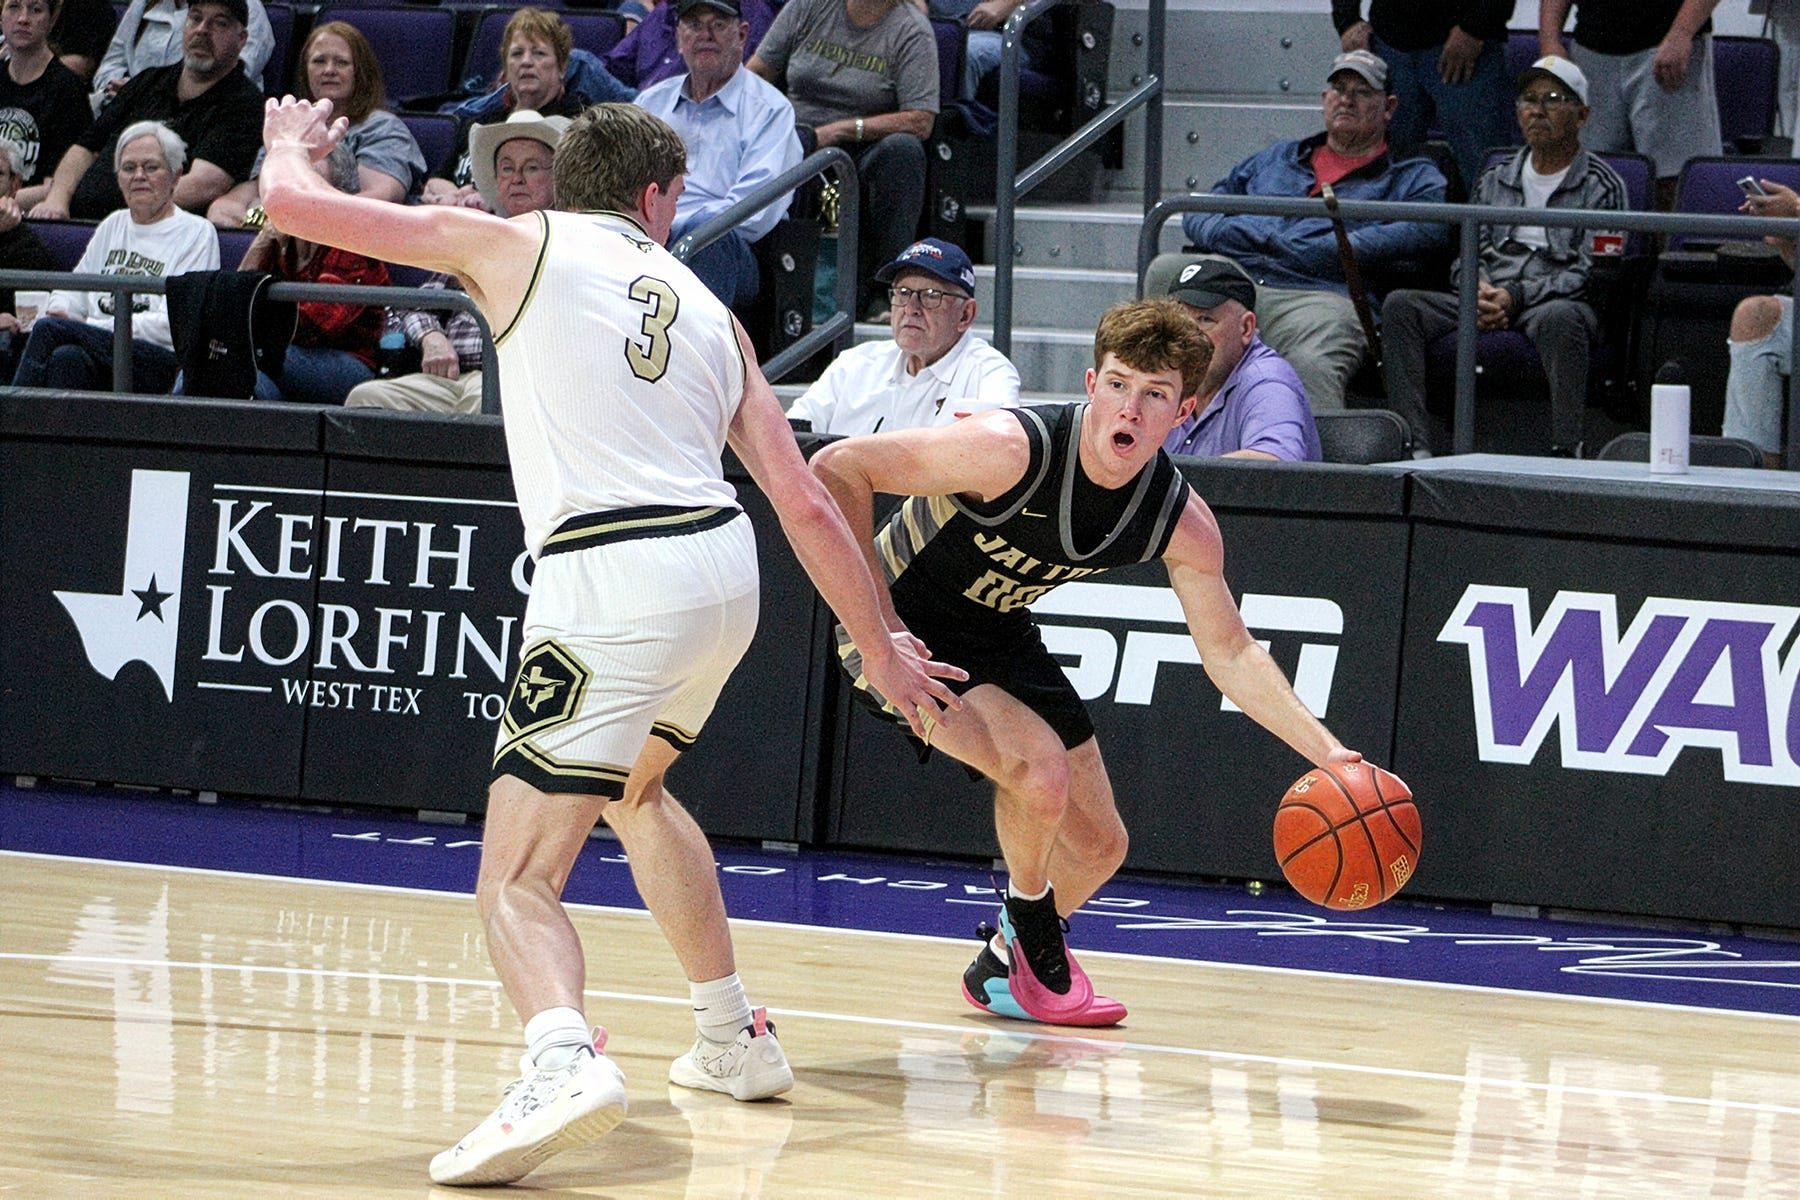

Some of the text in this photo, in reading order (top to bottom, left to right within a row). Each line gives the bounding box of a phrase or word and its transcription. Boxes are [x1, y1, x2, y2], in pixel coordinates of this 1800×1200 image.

[624, 275, 680, 384] 3
[208, 498, 479, 591] KEITH
[201, 585, 518, 683] LORFIN
[1029, 581, 1344, 722] SPN
[281, 678, 506, 721] WEST TEX TO
